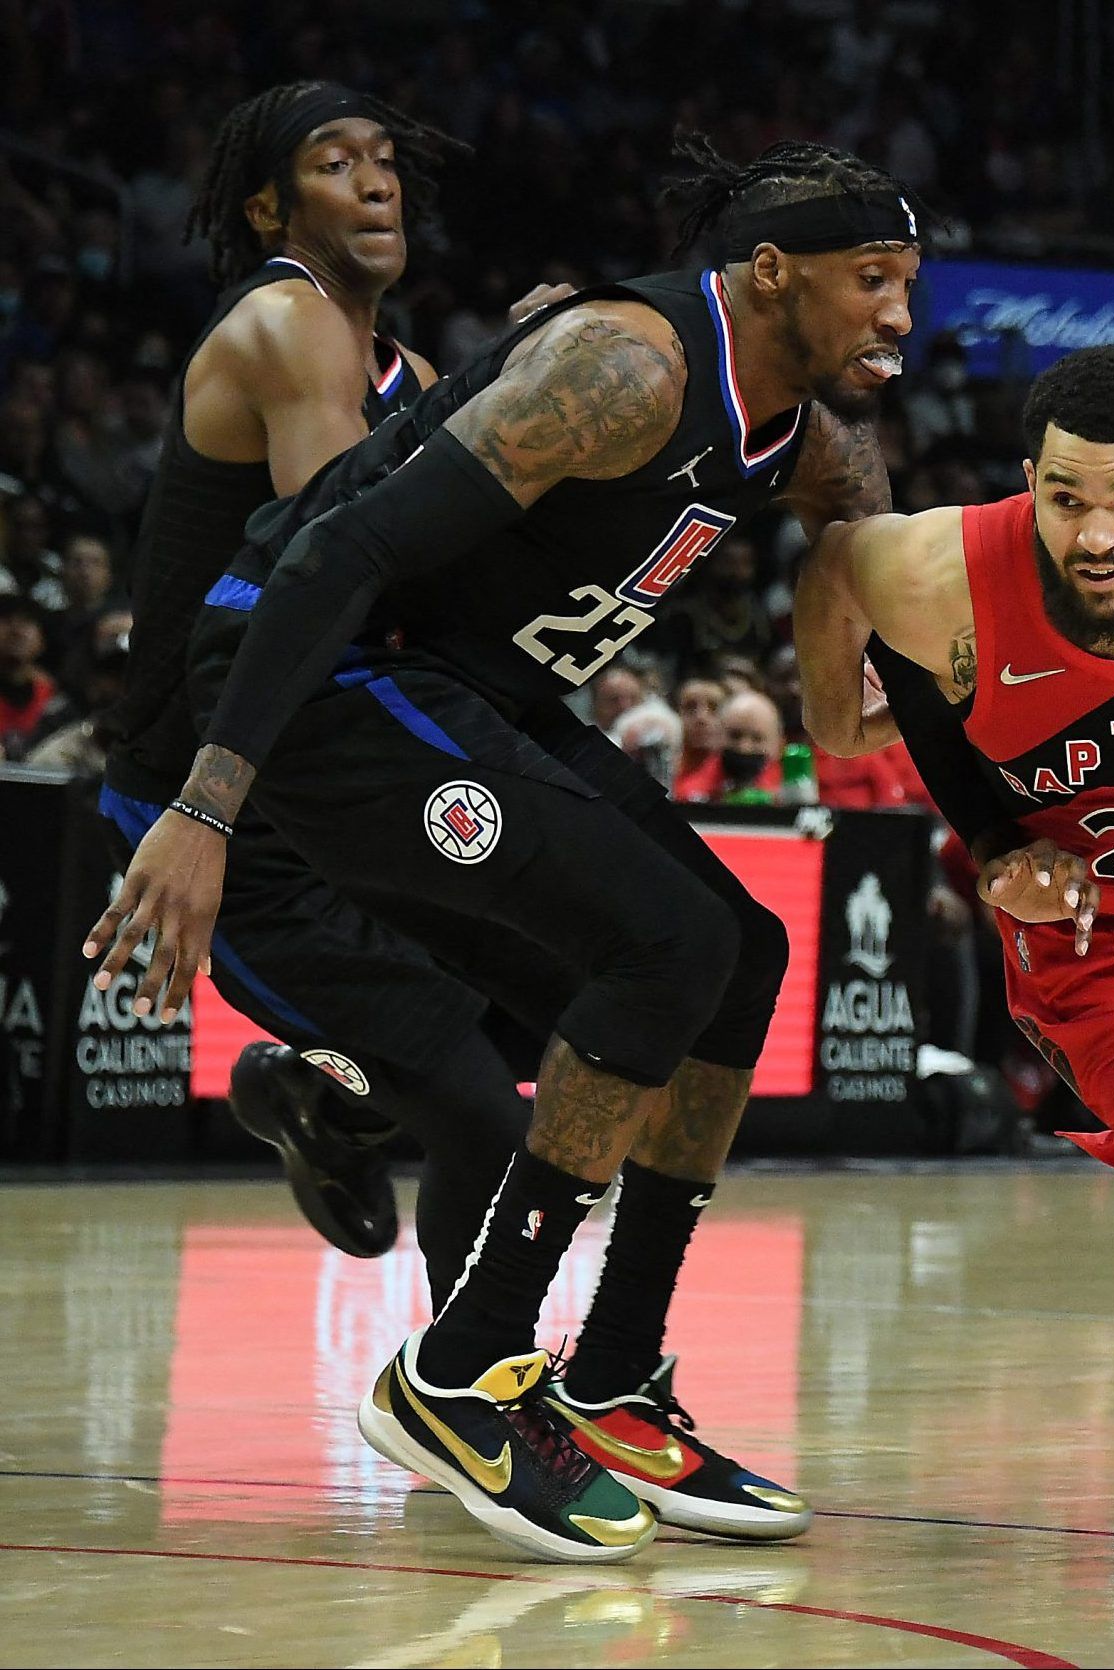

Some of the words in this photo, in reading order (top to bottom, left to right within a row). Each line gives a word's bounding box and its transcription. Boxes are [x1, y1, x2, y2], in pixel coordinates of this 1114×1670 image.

[512, 584, 656, 687] 23
[822, 979, 915, 1033] AGUA
[820, 1034, 916, 1072] CALIENTE
